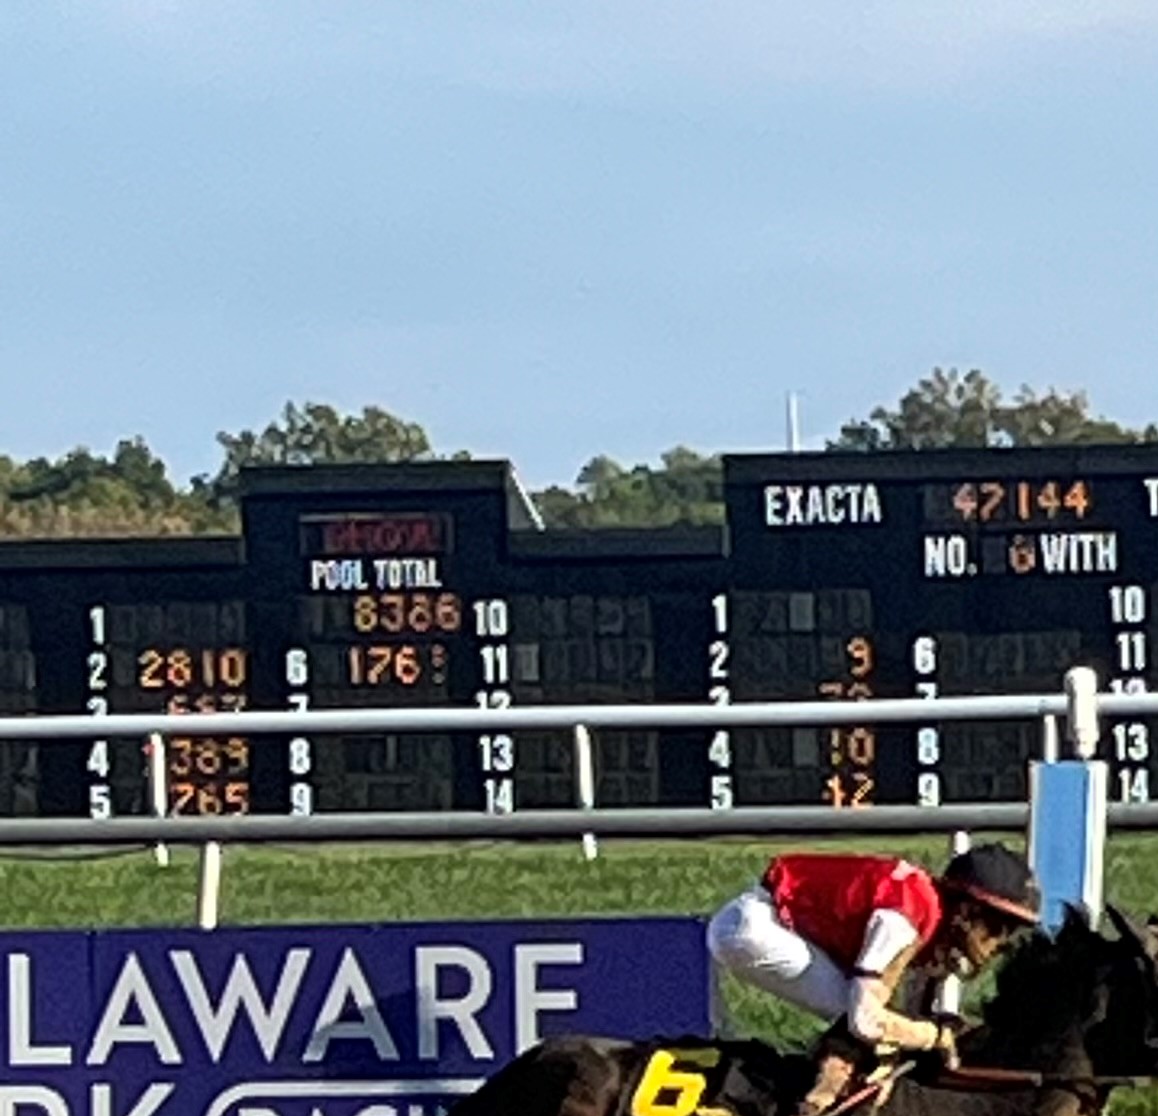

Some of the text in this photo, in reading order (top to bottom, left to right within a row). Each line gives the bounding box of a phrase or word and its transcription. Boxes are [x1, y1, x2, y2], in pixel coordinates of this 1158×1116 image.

[765, 484, 881, 525] EXACTA
[953, 481, 1090, 520] 47144
[925, 536, 977, 577] NO.
[1040, 532, 1117, 573] WITH
[310, 558, 442, 590] POOL TOTAL
[473, 600, 508, 636] 10
[712, 595, 727, 633] 1
[1109, 586, 1146, 623] 10
[90, 606, 105, 645] 1
[138, 649, 248, 688] 2810
[286, 649, 308, 686] 6
[480, 645, 508, 684] 11
[709, 641, 729, 678] 2
[914, 636, 936, 674] 6
[1116, 630, 1146, 672] 11
[87, 652, 107, 690] 2
[86, 740, 110, 777] 4
[289, 737, 311, 775] 8
[479, 734, 514, 772] 13
[708, 730, 731, 768] 4
[917, 727, 940, 765] 8
[1113, 723, 1149, 761] 13
[90, 785, 111, 819] 5
[290, 783, 312, 816] 9
[483, 779, 514, 814] 14
[711, 776, 733, 810] 5
[918, 773, 940, 807] 9
[1119, 767, 1149, 802] 14
[7, 943, 583, 1066] LAWARE
